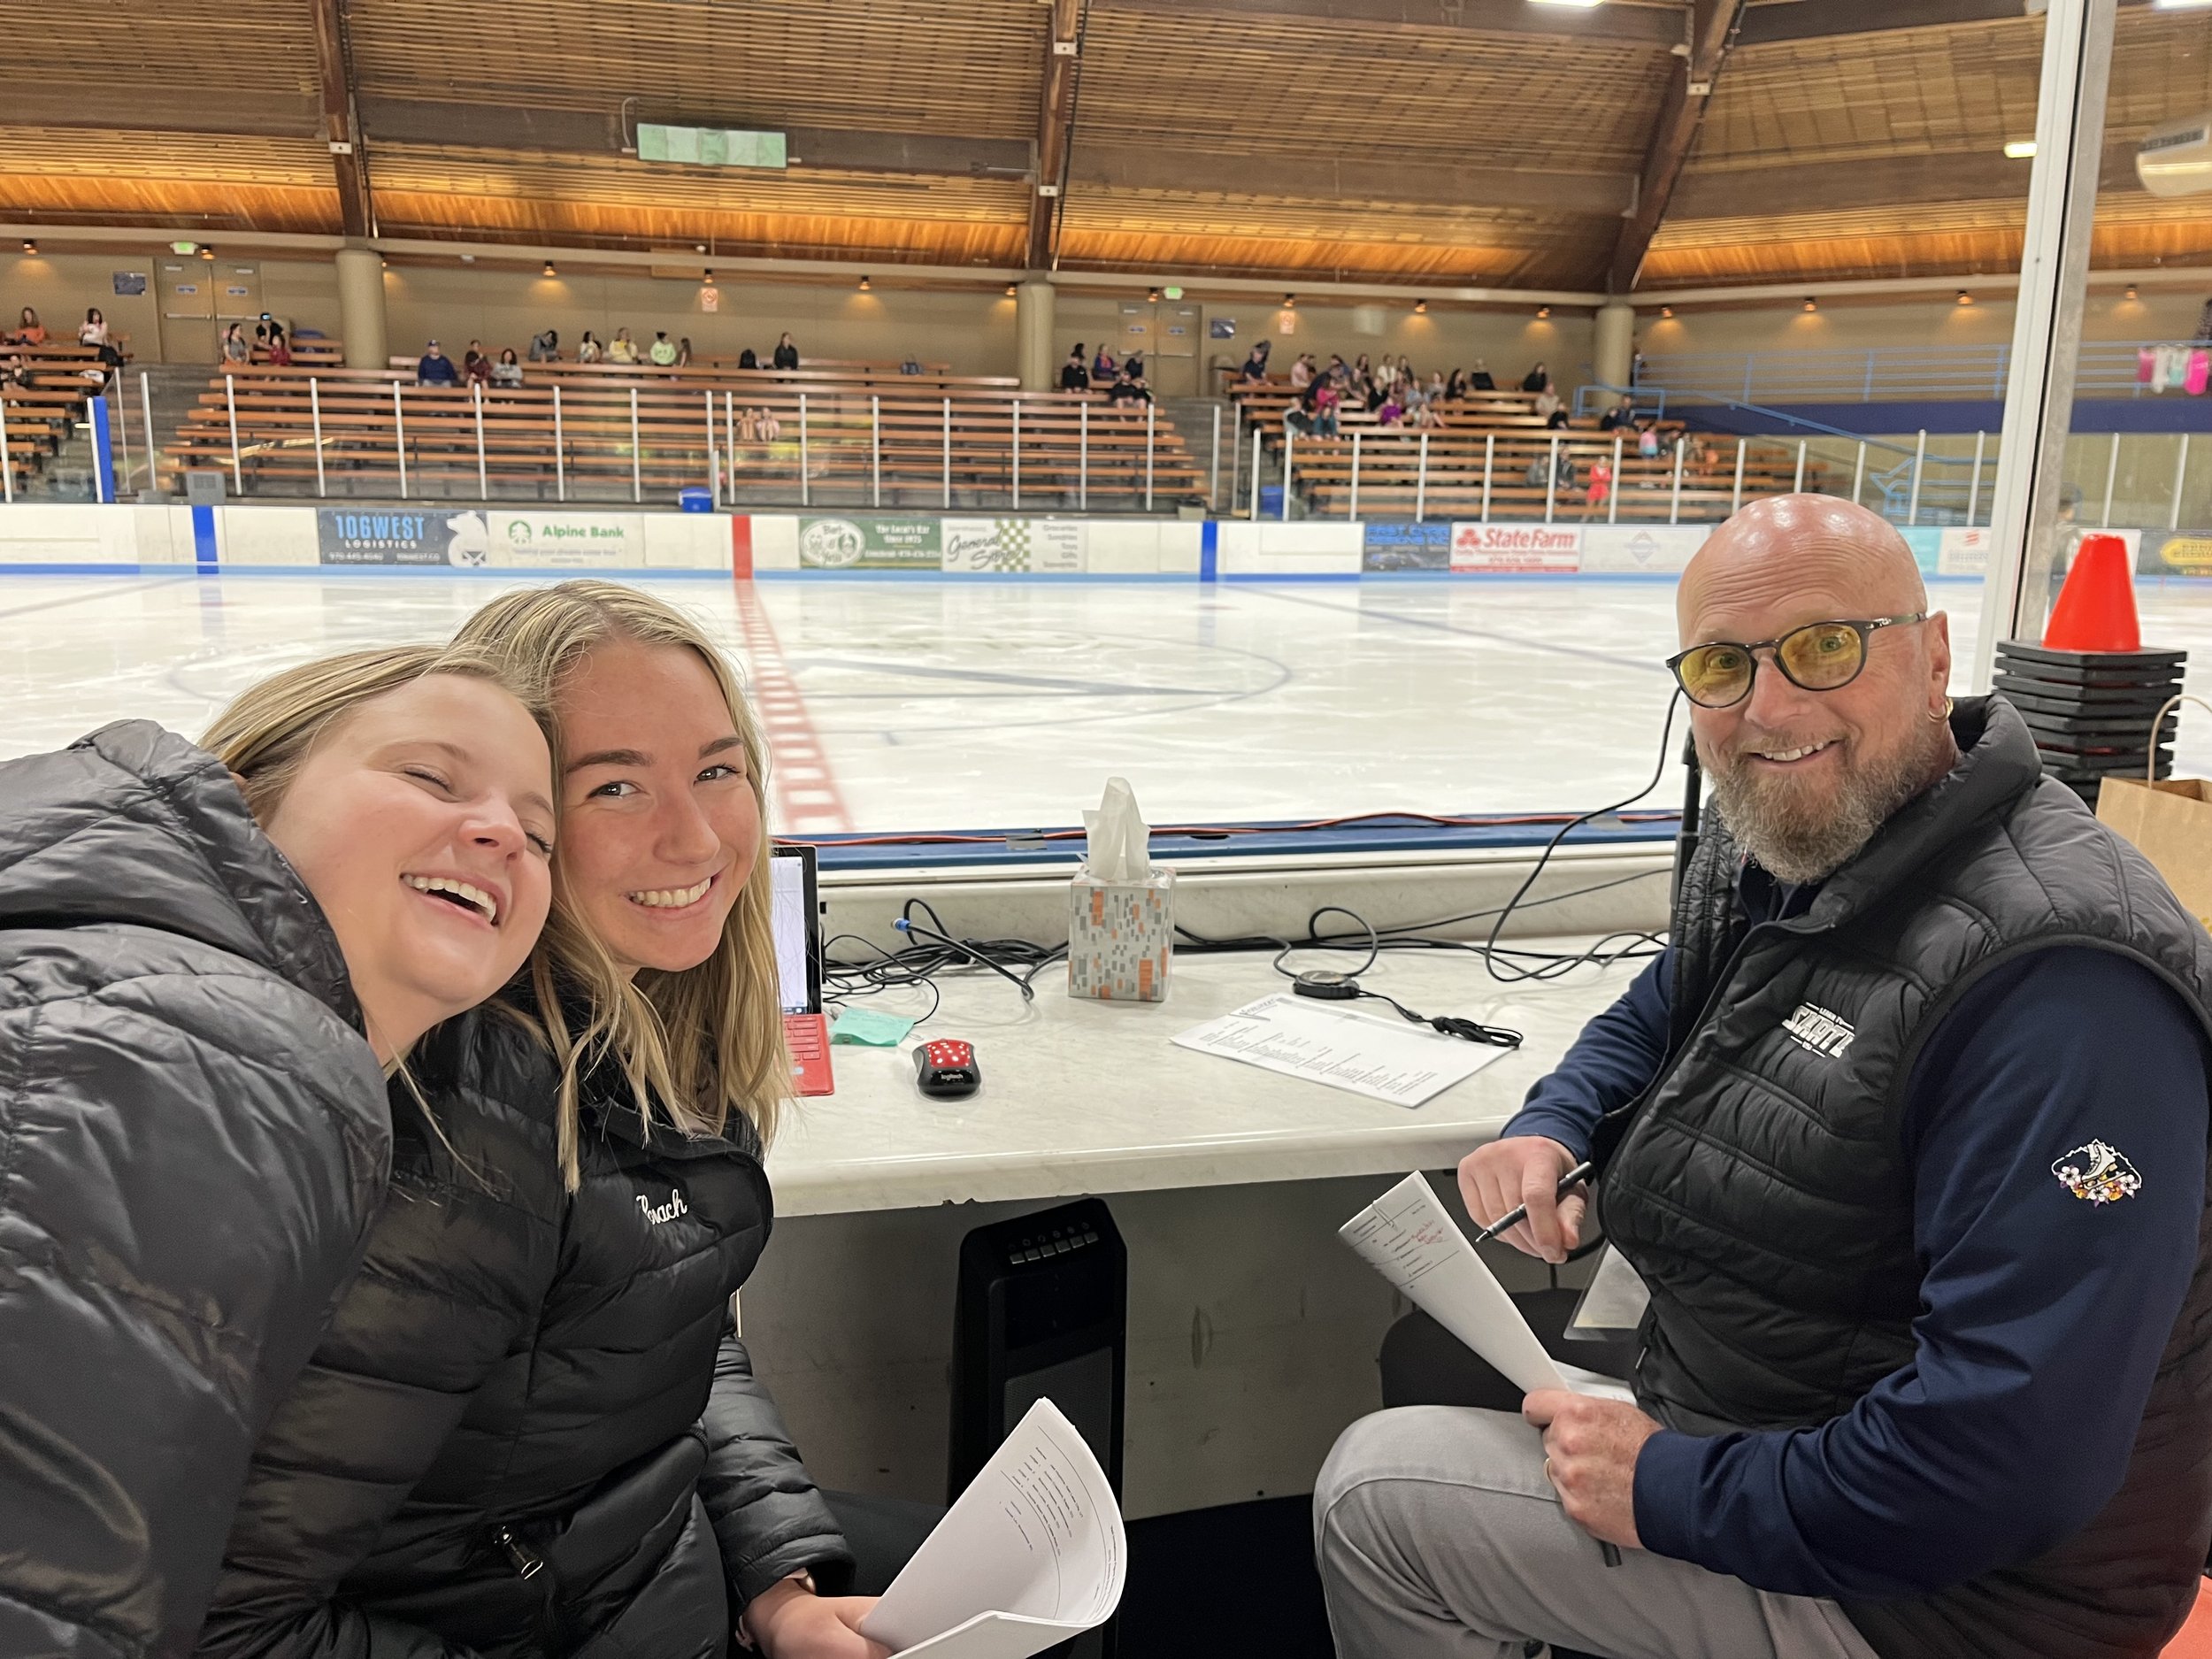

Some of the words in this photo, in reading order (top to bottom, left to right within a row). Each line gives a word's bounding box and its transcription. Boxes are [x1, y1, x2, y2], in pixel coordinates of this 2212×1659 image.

[335, 515, 425, 540] 106WEST
[542, 525, 586, 540] Alpine
[590, 526, 625, 538] Bank
[345, 539, 417, 549] LOGISTICS
[948, 524, 1004, 562] General
[971, 549, 1022, 570] Store
